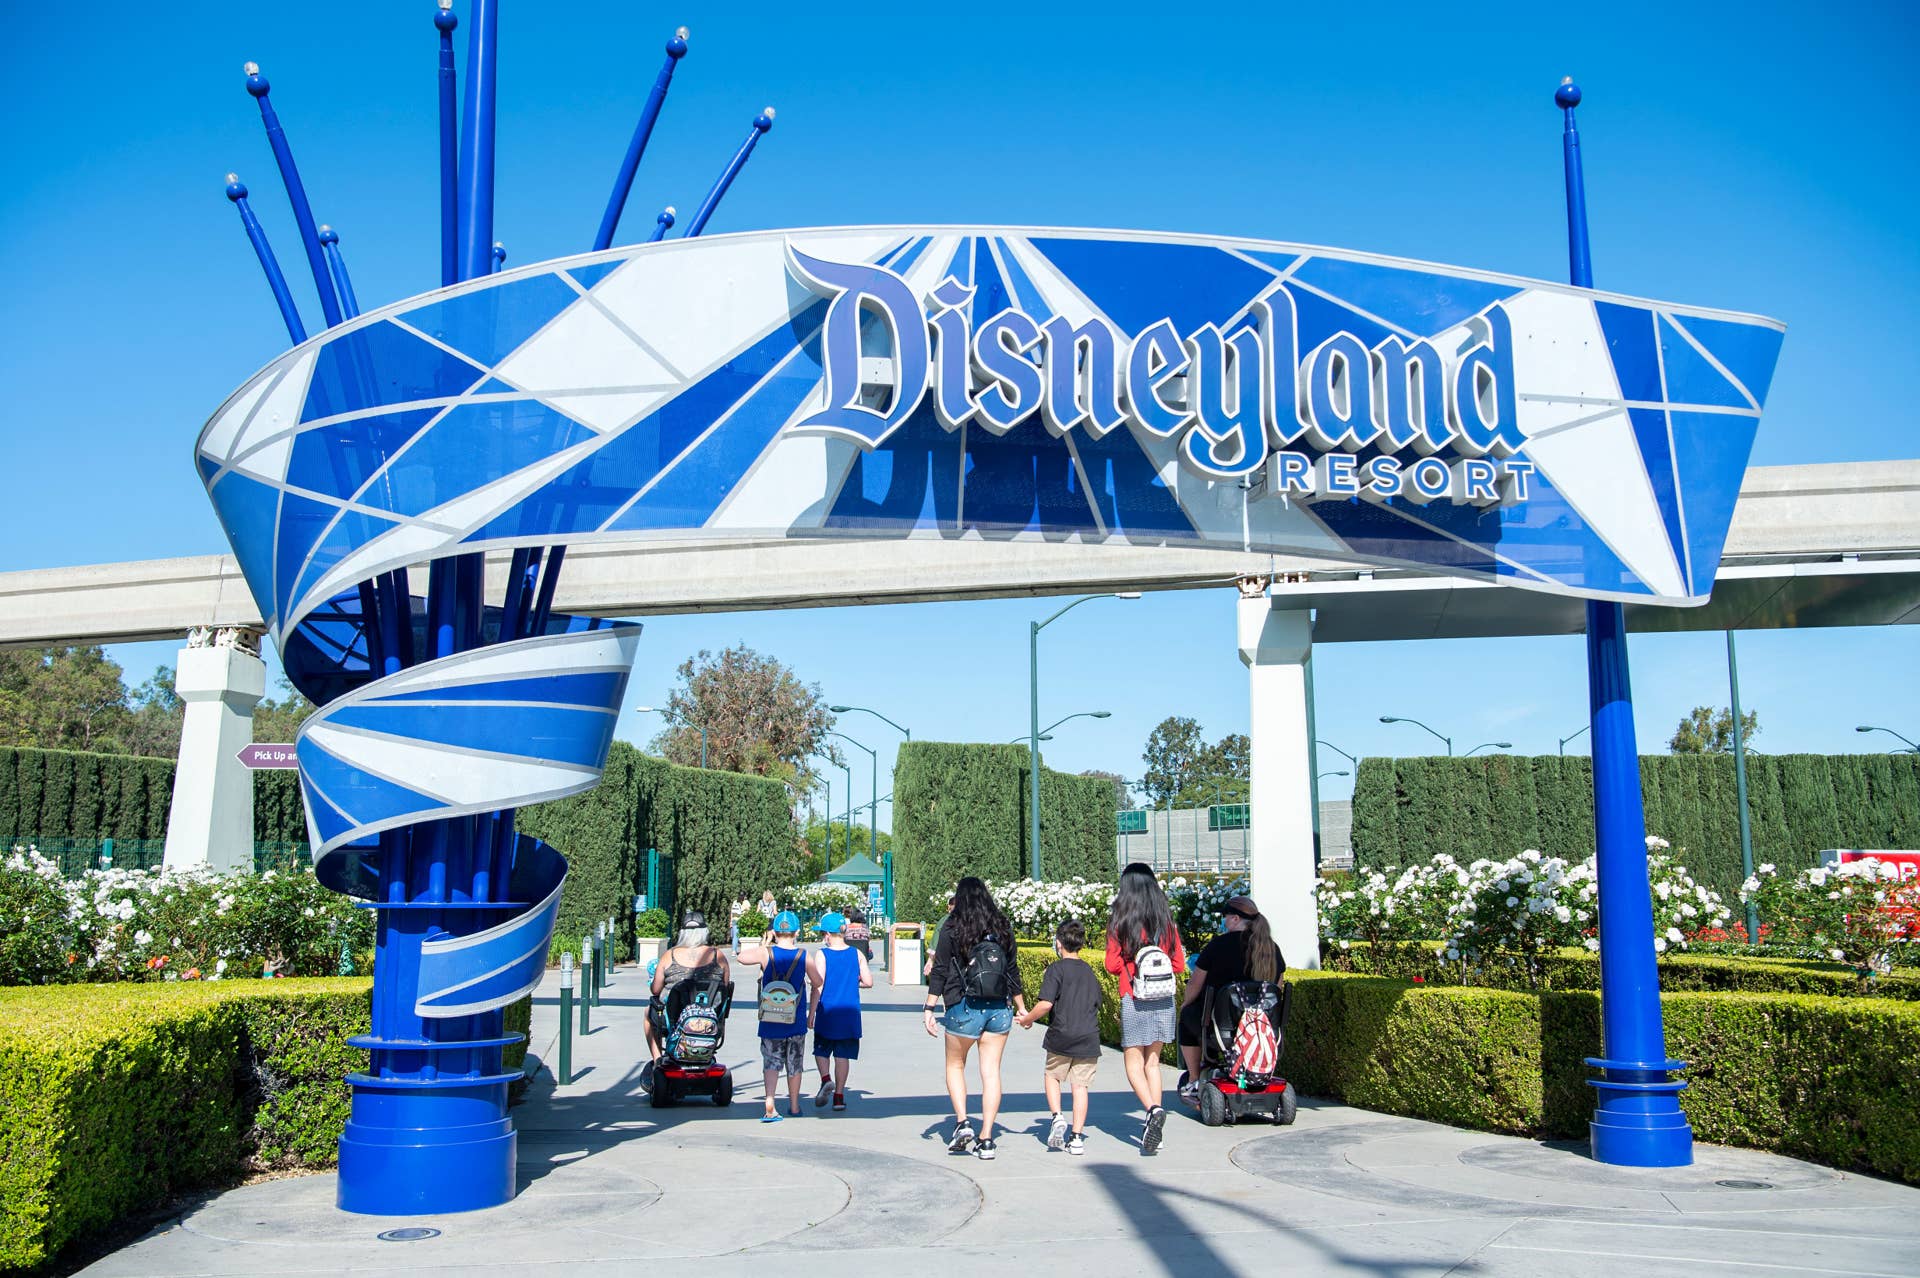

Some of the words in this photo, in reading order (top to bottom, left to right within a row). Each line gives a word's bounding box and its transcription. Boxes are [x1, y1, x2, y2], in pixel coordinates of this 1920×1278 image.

[784, 234, 1534, 477] Disneyland
[1277, 450, 1536, 501] RESORT
[254, 750, 272, 760] Pick
[273, 751, 286, 762] Up
